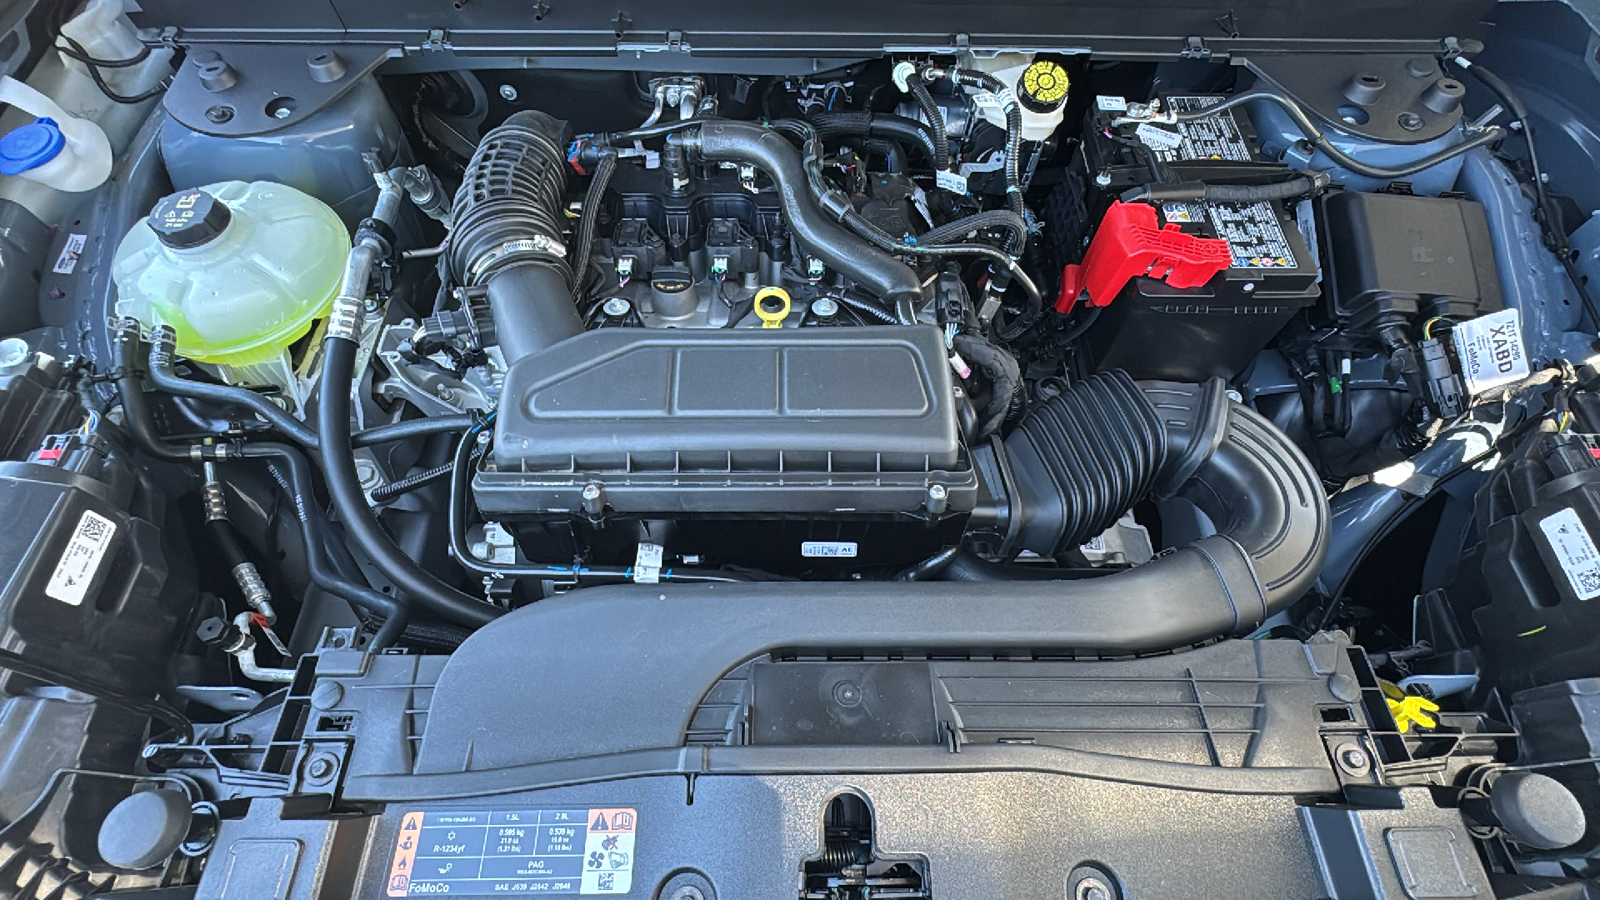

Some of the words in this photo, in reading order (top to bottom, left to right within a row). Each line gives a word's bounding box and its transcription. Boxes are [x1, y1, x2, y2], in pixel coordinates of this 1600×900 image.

[1489, 324, 1513, 374] XABD
[1467, 342, 1481, 375] FoMoCo
[516, 828, 525, 837] kg
[566, 828, 575, 837] kg
[433, 844, 466, 854] R-1234yf
[528, 860, 545, 869] PAG
[408, 882, 450, 893] FoMoCo
[494, 883, 509, 891] SAE
